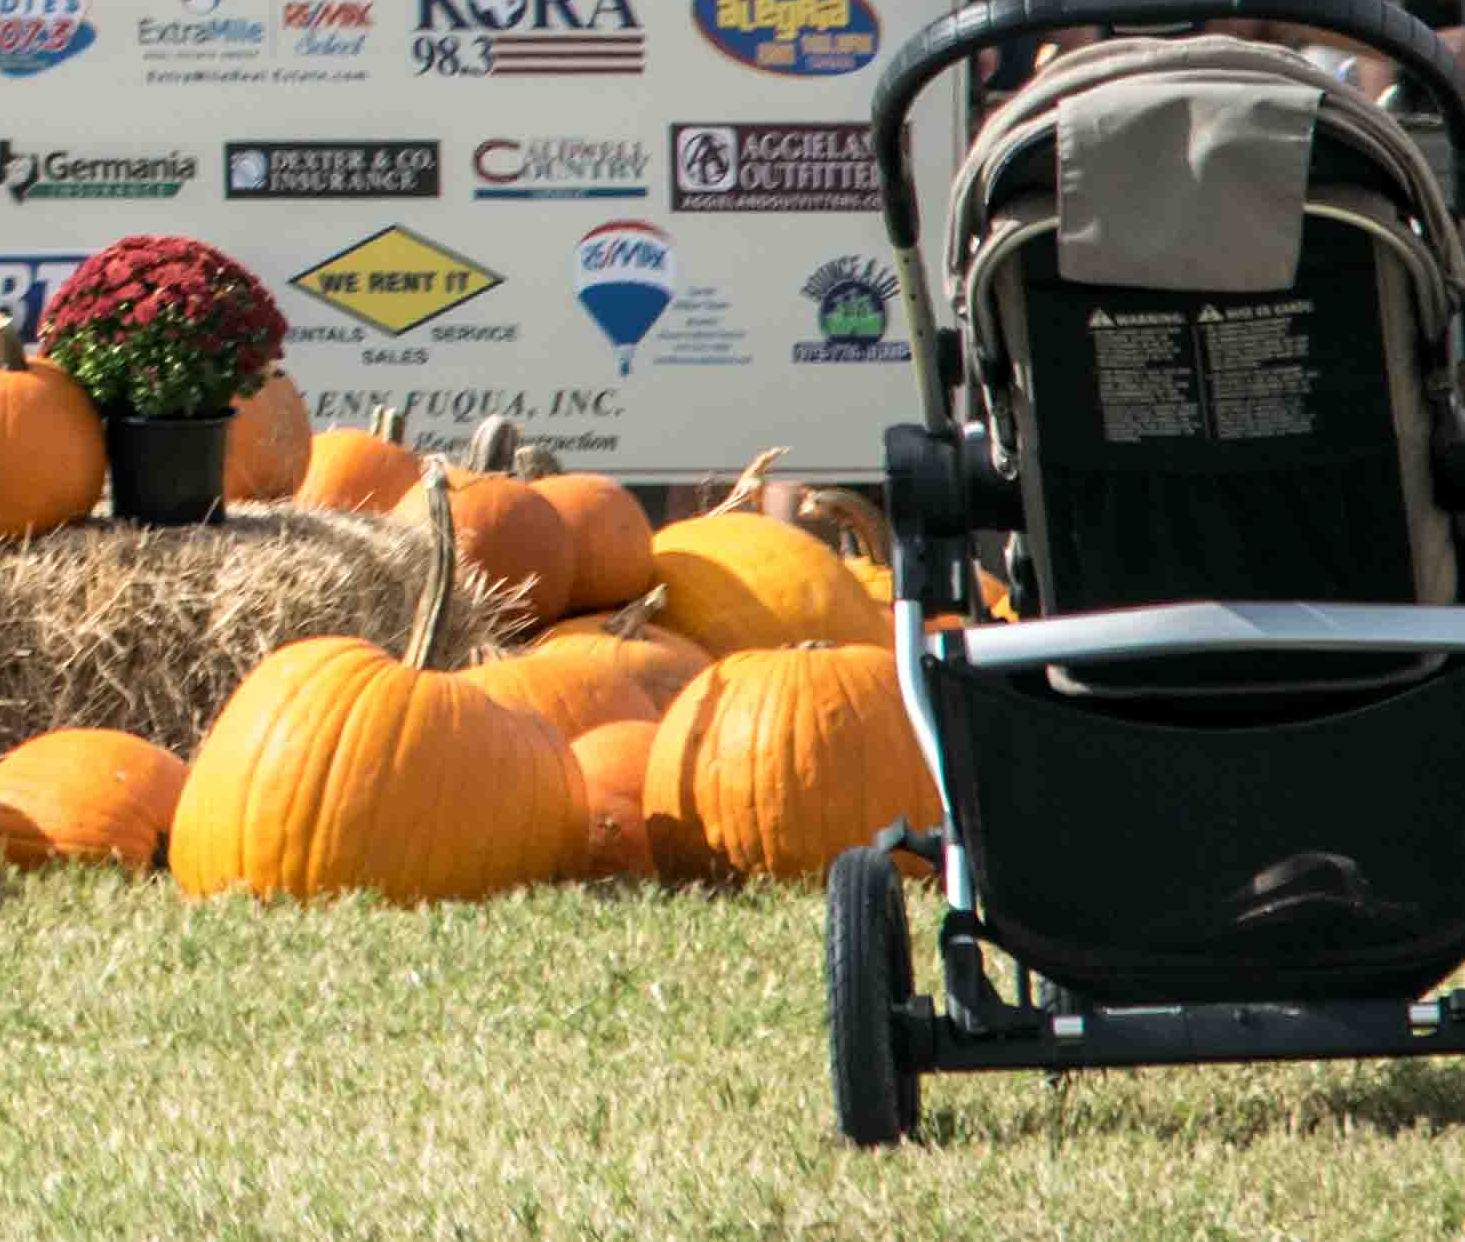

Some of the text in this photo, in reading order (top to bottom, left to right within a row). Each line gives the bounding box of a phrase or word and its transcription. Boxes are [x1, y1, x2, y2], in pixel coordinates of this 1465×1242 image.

[137, 16, 264, 46] ExtraMile
[45, 149, 198, 183] Germania
[320, 271, 472, 294] WE RENT IT
[288, 325, 519, 343] ENTALS SERVICE
[360, 347, 431, 366] SALES
[405, 389, 536, 422] FUQUA,
[548, 388, 626, 418] INC.
